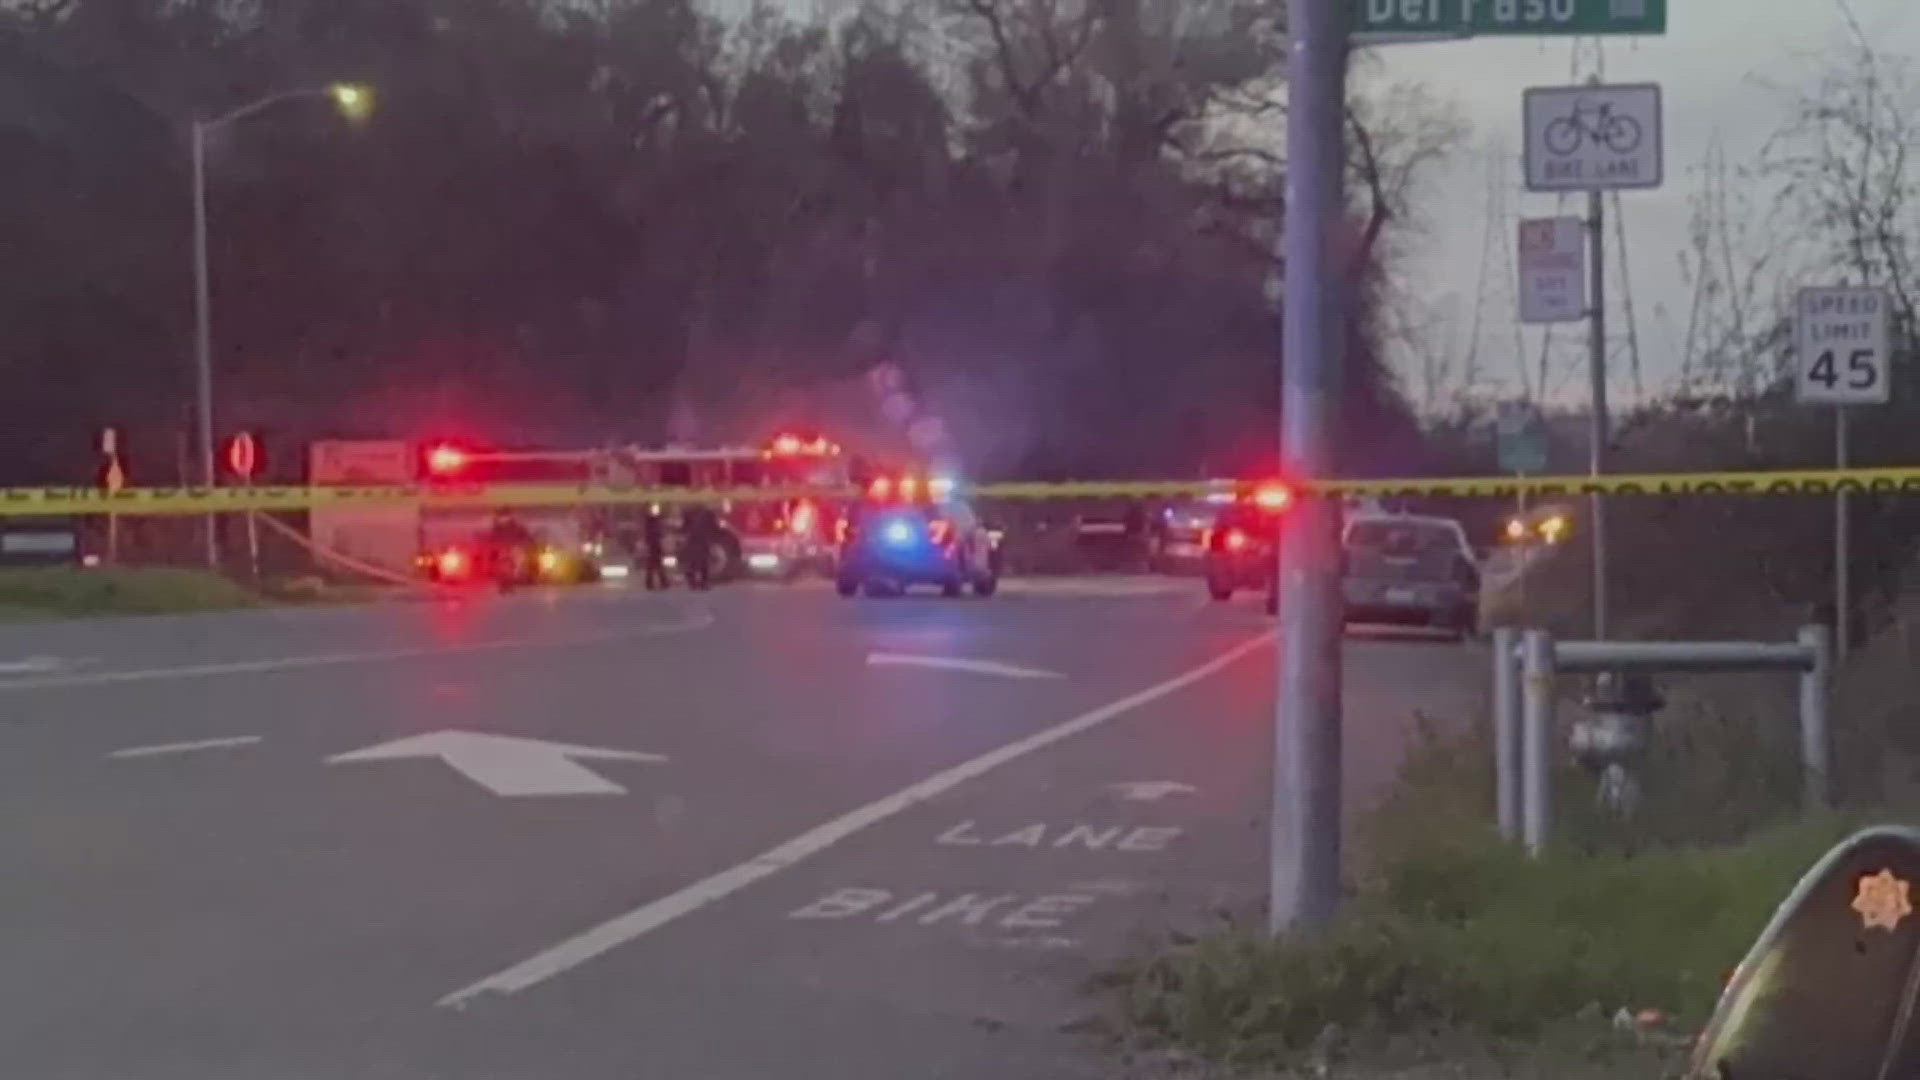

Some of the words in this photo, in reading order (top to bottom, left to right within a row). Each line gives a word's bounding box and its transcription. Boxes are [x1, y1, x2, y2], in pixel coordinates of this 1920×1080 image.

[1545, 159, 1582, 179] BIKE
[1596, 158, 1639, 178] LANE
[1808, 295, 1877, 315] SPEED
[1810, 322, 1871, 342] LIMIT
[1807, 348, 1878, 390] 45
[937, 820, 1181, 850] LANE
[785, 888, 1094, 928] BIKE
